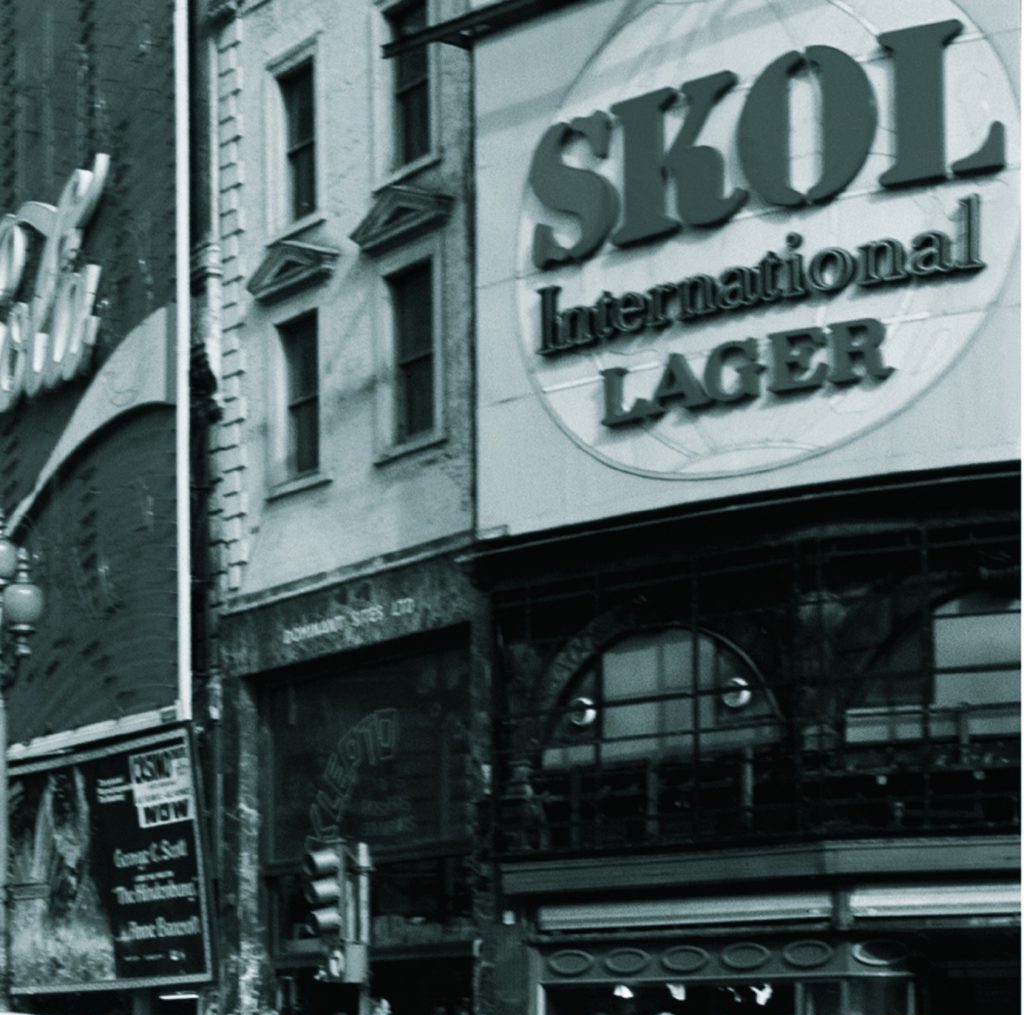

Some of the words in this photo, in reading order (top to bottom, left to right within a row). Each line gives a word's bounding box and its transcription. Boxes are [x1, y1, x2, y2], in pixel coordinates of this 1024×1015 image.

[528, 18, 1005, 271] SKOL
[536, 194, 986, 357] International
[601, 317, 897, 429] LAGER
[144, 799, 189, 824] NOW
